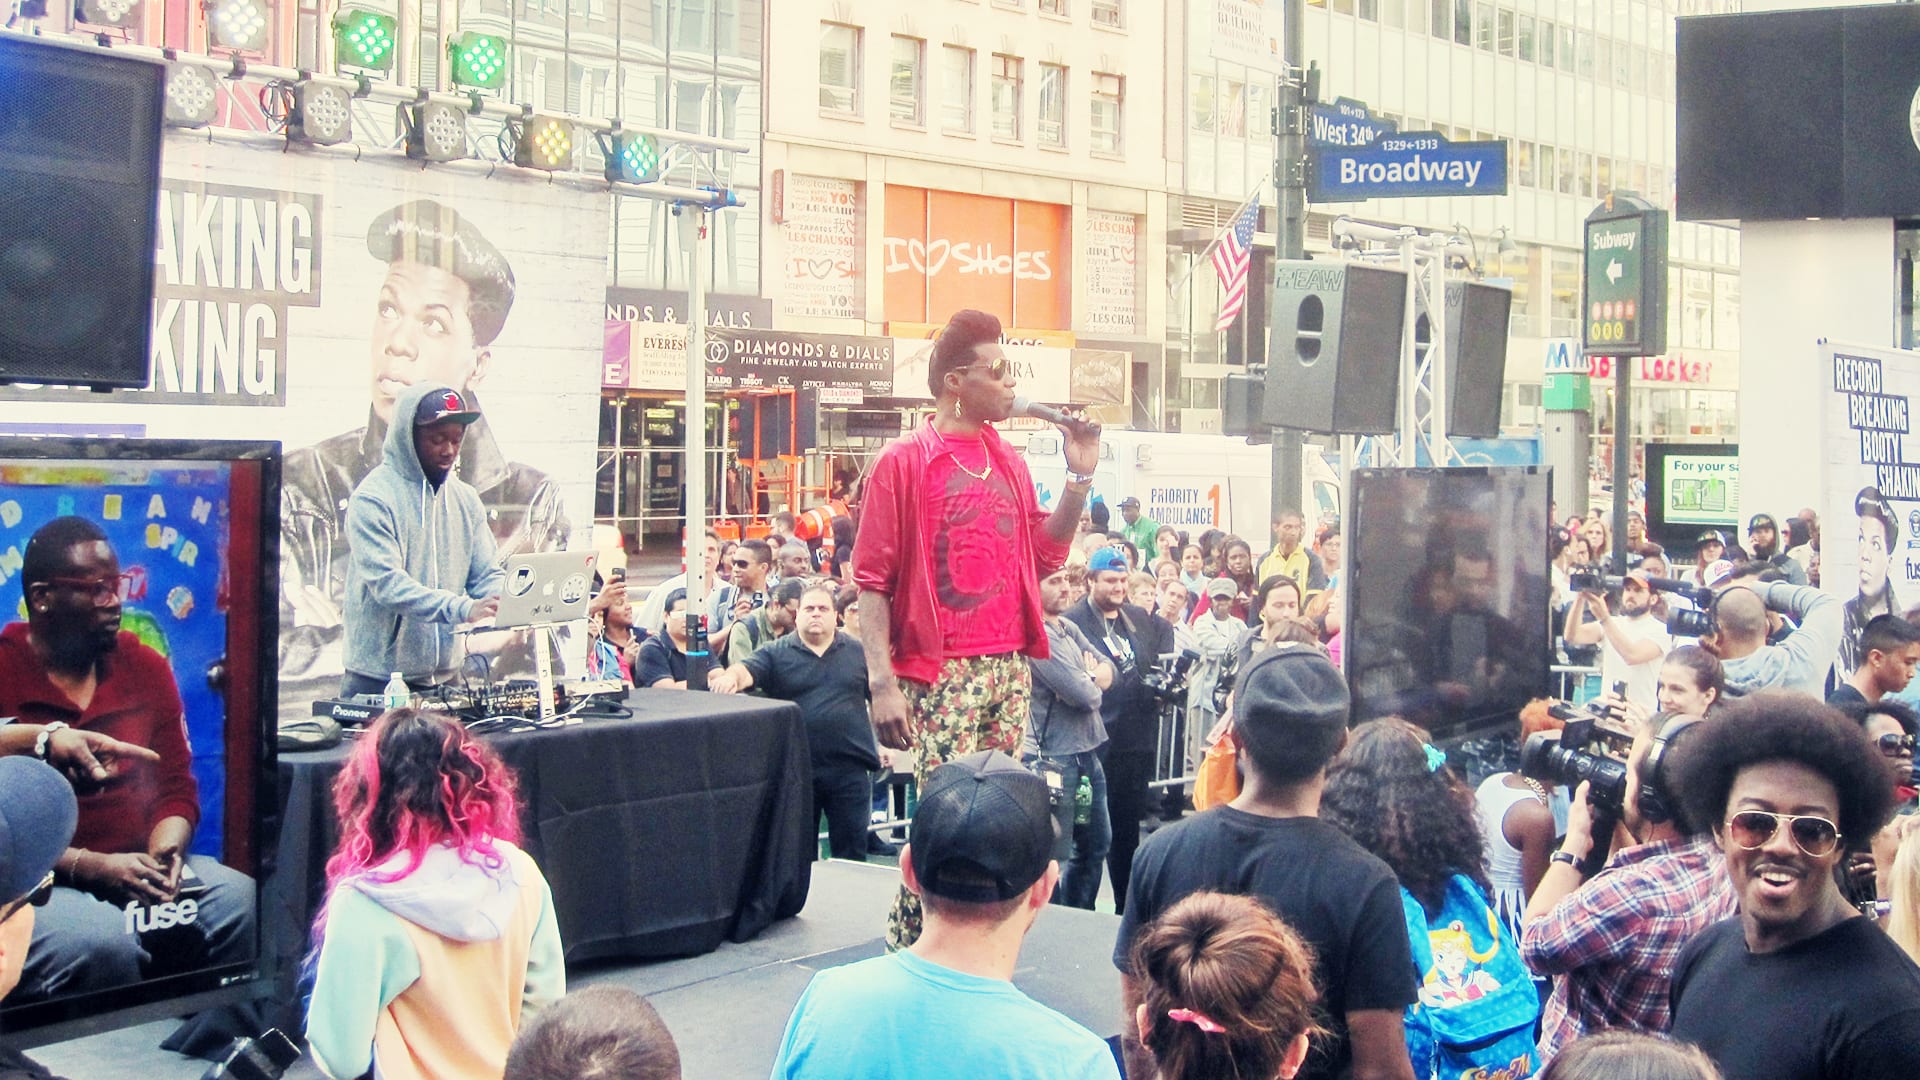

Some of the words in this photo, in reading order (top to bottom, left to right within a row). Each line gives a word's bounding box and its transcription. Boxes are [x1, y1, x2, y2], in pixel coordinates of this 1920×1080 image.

[1313, 115, 1348, 146] West
[1350, 123, 1374, 146] 34th
[1382, 140, 1407, 151] 1329
[1414, 139, 1438, 150] 1313
[1340, 154, 1482, 187] Broadway
[1593, 231, 1635, 250] Subway
[951, 242, 1051, 280] SHOES
[1293, 268, 1344, 291] EAW
[705, 309, 752, 328] IALS
[734, 339, 824, 358] DIAMONDS
[829, 344, 840, 358] &
[845, 345, 890, 361] DIALS
[740, 357, 759, 365] FINE
[763, 358, 799, 367] JEWELRY
[821, 360, 847, 368] WATCH
[850, 362, 883, 370] EXPERTS
[1641, 353, 1712, 383] Locker
[1836, 357, 1881, 394] RECORD
[1851, 395, 1907, 432] BREAKING
[1864, 430, 1900, 463] BOOTY
[1674, 461, 1693, 471] For
[1698, 463, 1725, 472] your
[1151, 489, 1199, 504] PRIORITY
[1149, 507, 1213, 525] AMBULANCE
[332, 705, 370, 719] Pioneer
[124, 899, 198, 934] fuse
